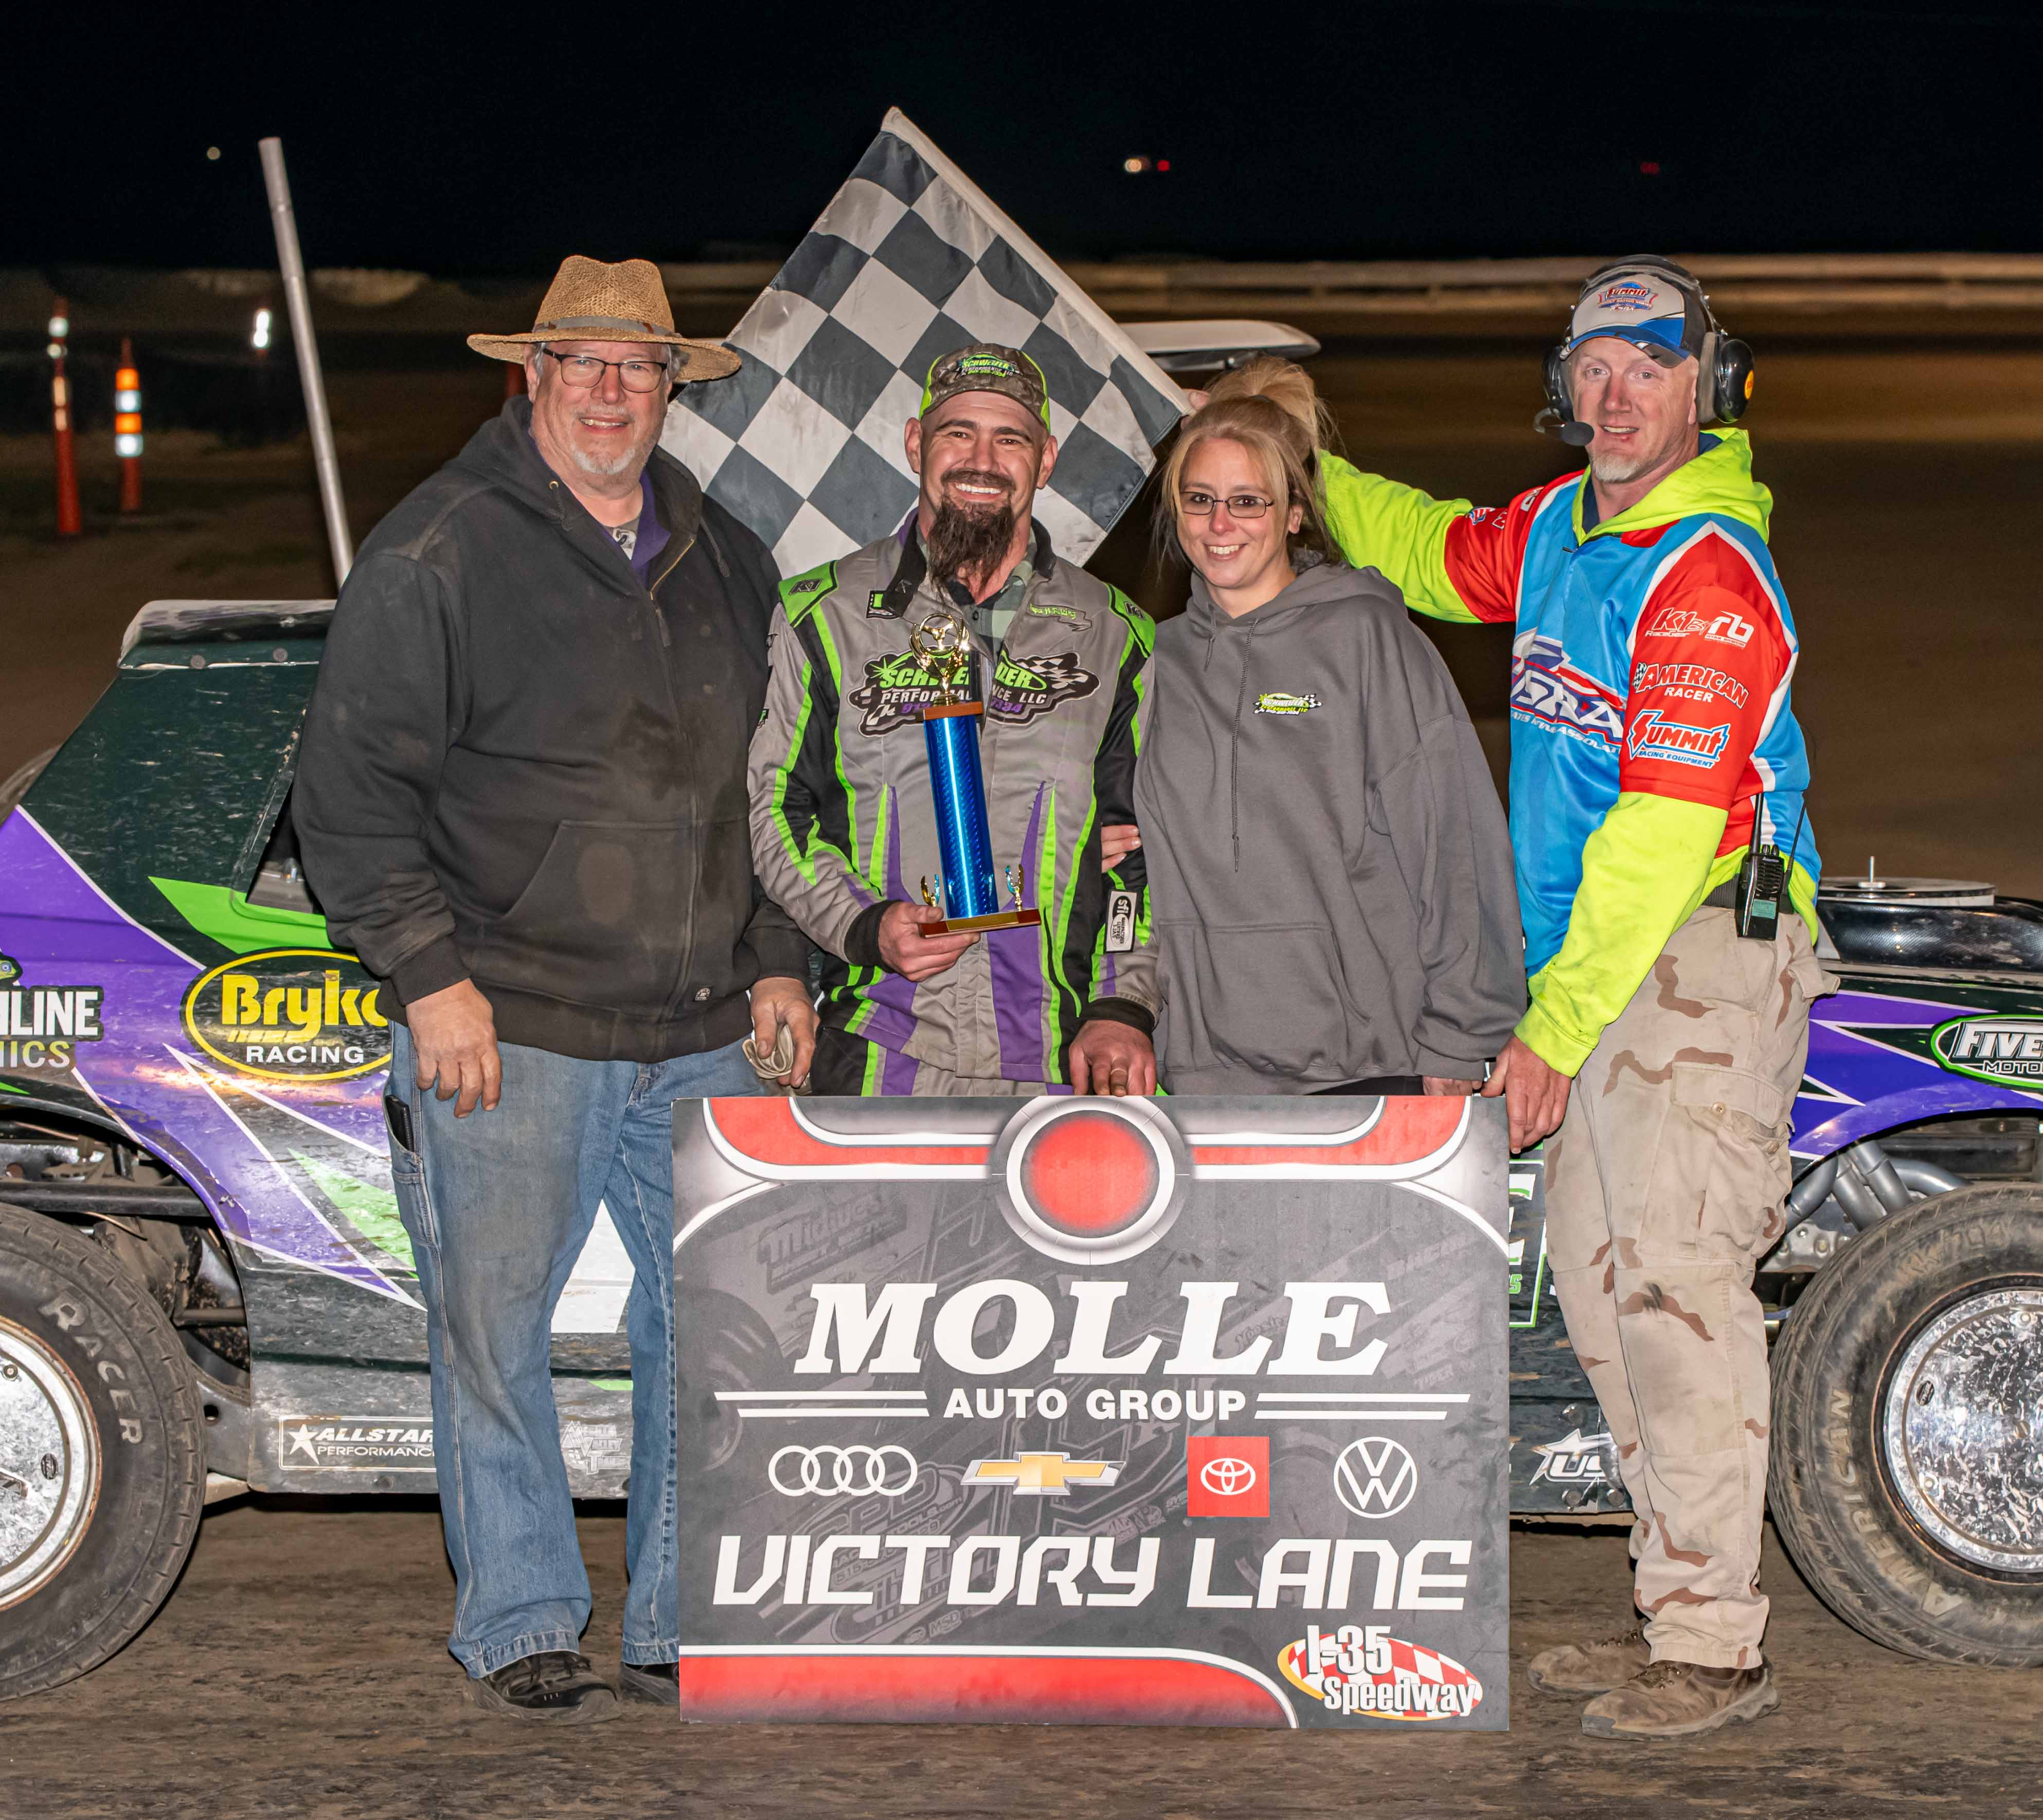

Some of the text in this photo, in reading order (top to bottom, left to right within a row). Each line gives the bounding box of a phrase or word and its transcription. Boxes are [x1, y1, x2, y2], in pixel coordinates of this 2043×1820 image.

[1019, 692, 1047, 704] LLC
[1635, 663, 1749, 710] AMERICAN
[1664, 687, 1714, 703] RACER
[1666, 752, 1714, 768] EQUIPMENT
[0, 1040, 70, 1068] ICS
[246, 1046, 365, 1064] RACING
[1983, 1060, 2043, 1074] MOTO
[793, 1279, 1392, 1375] MOLLE
[38, 1290, 144, 1444] RACER
[943, 1387, 1247, 1421] AUTO GROUP
[317, 1446, 435, 1457] PERFORMANC
[713, 1535, 1161, 1607] VICTORY
[1187, 1538, 1473, 1611] LANE
[1307, 1625, 1391, 1675] I-35
[1323, 1676, 1475, 1717] Speedway
